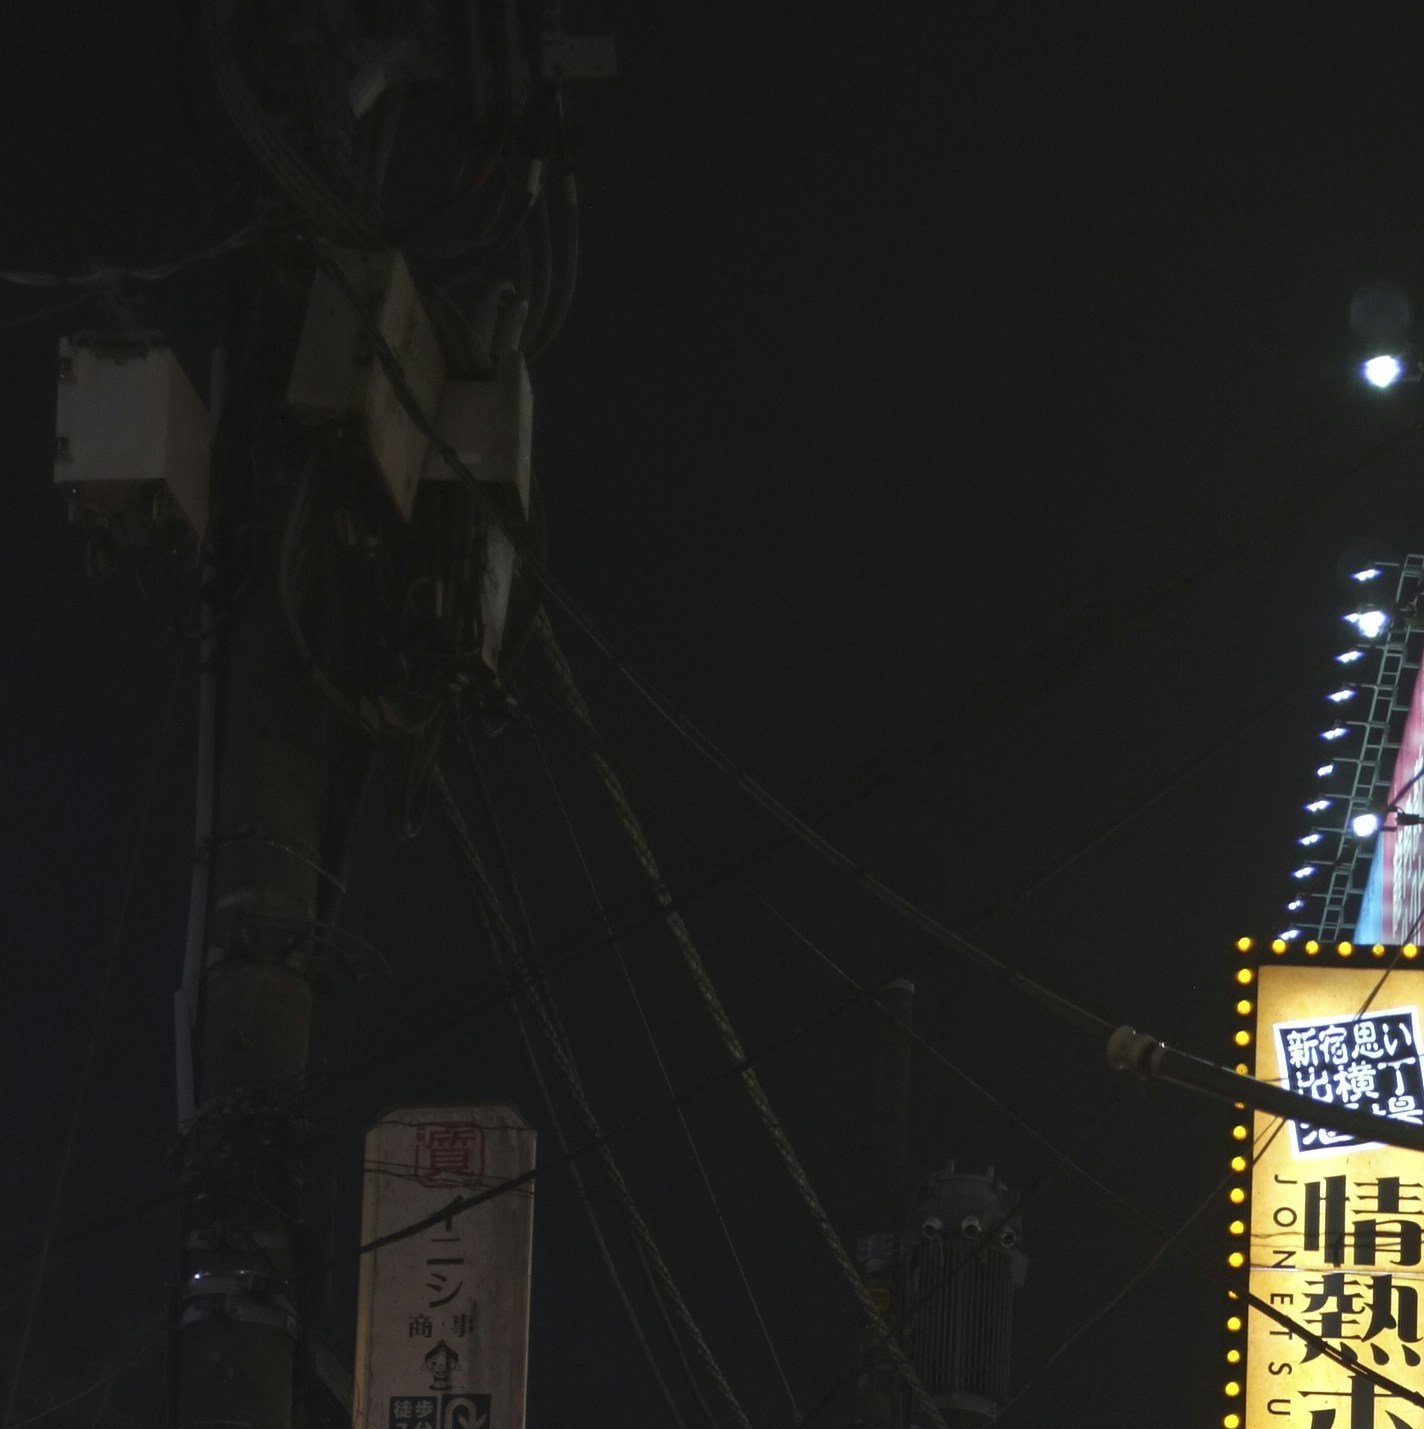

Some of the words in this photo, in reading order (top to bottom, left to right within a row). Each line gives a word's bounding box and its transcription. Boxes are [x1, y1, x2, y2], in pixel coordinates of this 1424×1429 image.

[1287, 1021, 1412, 1068] 新宿思い
[424, 1128, 477, 1178] 質
[1267, 1174, 1298, 1418] JONETSU
[393, 1400, 434, 1420] 徒歩
